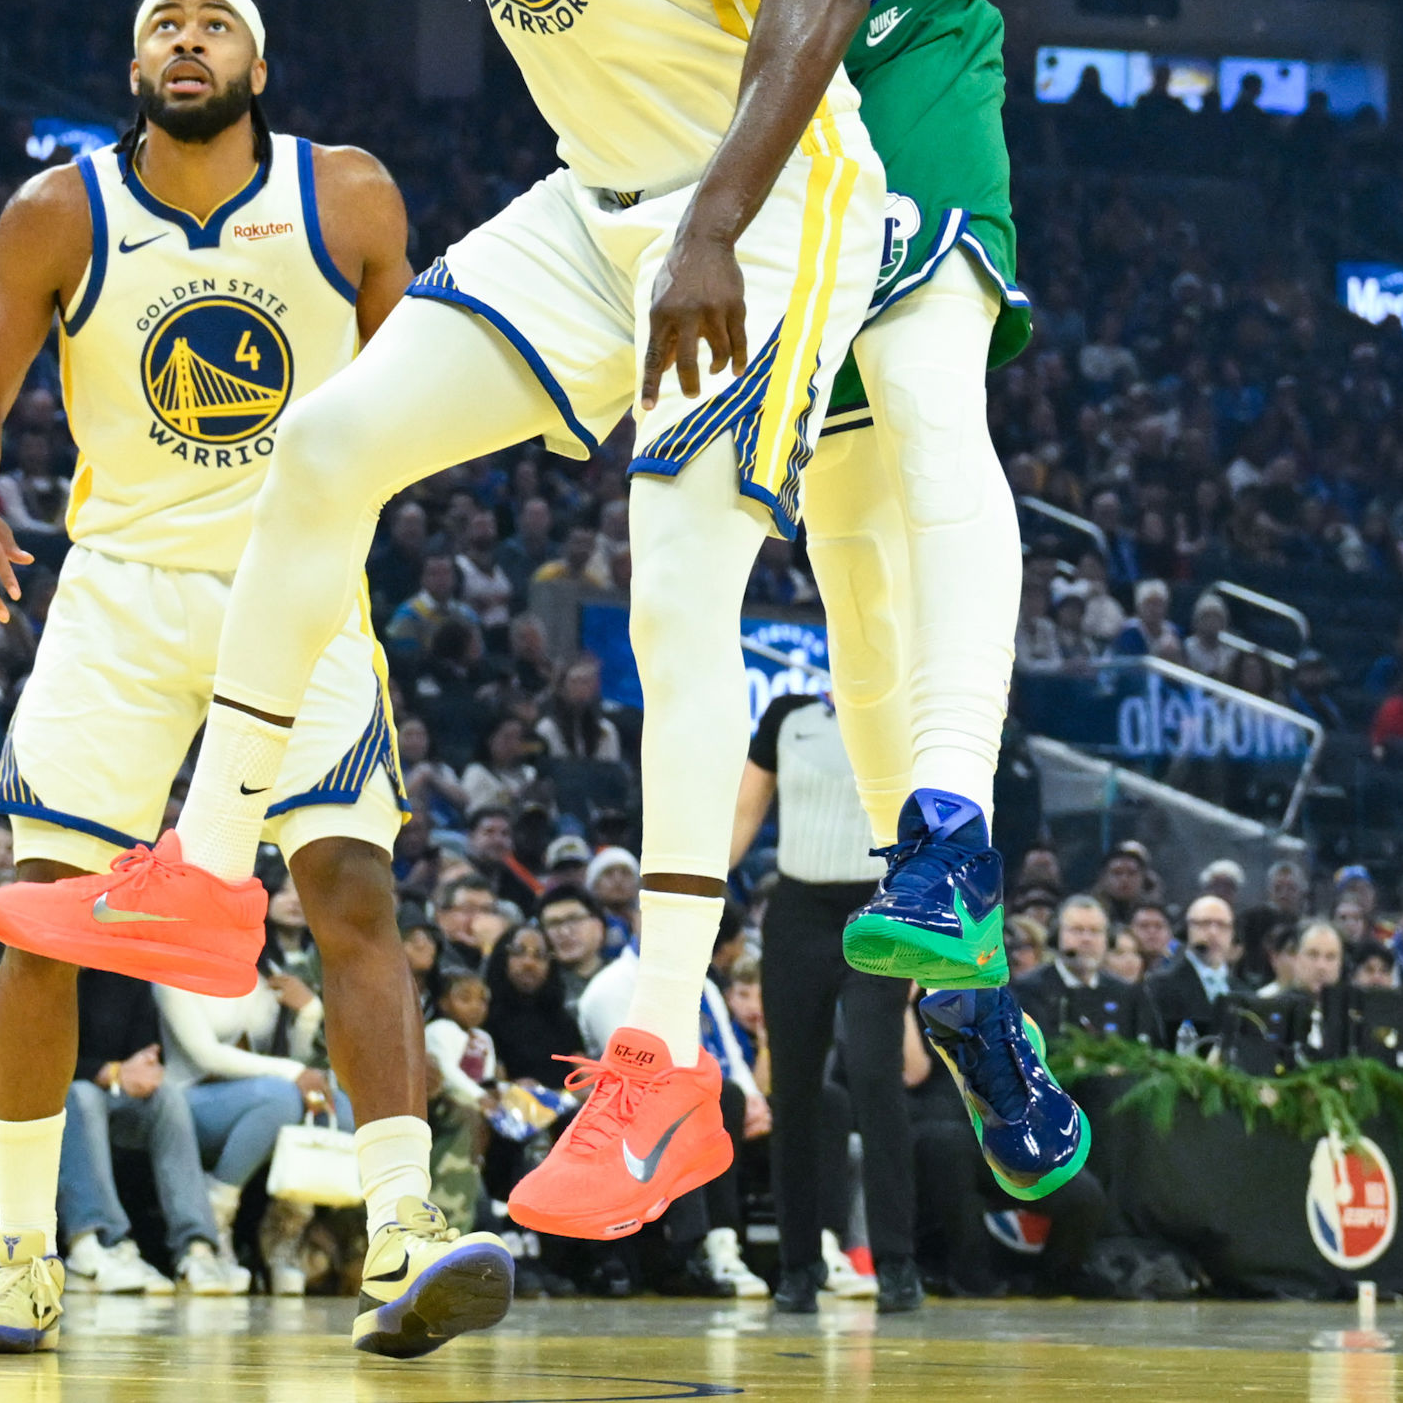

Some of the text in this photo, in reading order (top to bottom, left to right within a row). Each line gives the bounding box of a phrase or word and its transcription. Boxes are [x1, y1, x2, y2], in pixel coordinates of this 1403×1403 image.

[869, 6, 899, 36] NIKE
[233, 221, 294, 241] Rakuten
[136, 278, 289, 333] GOLDEN STATE
[234, 330, 261, 371] 4
[148, 420, 281, 468] WARRIO
